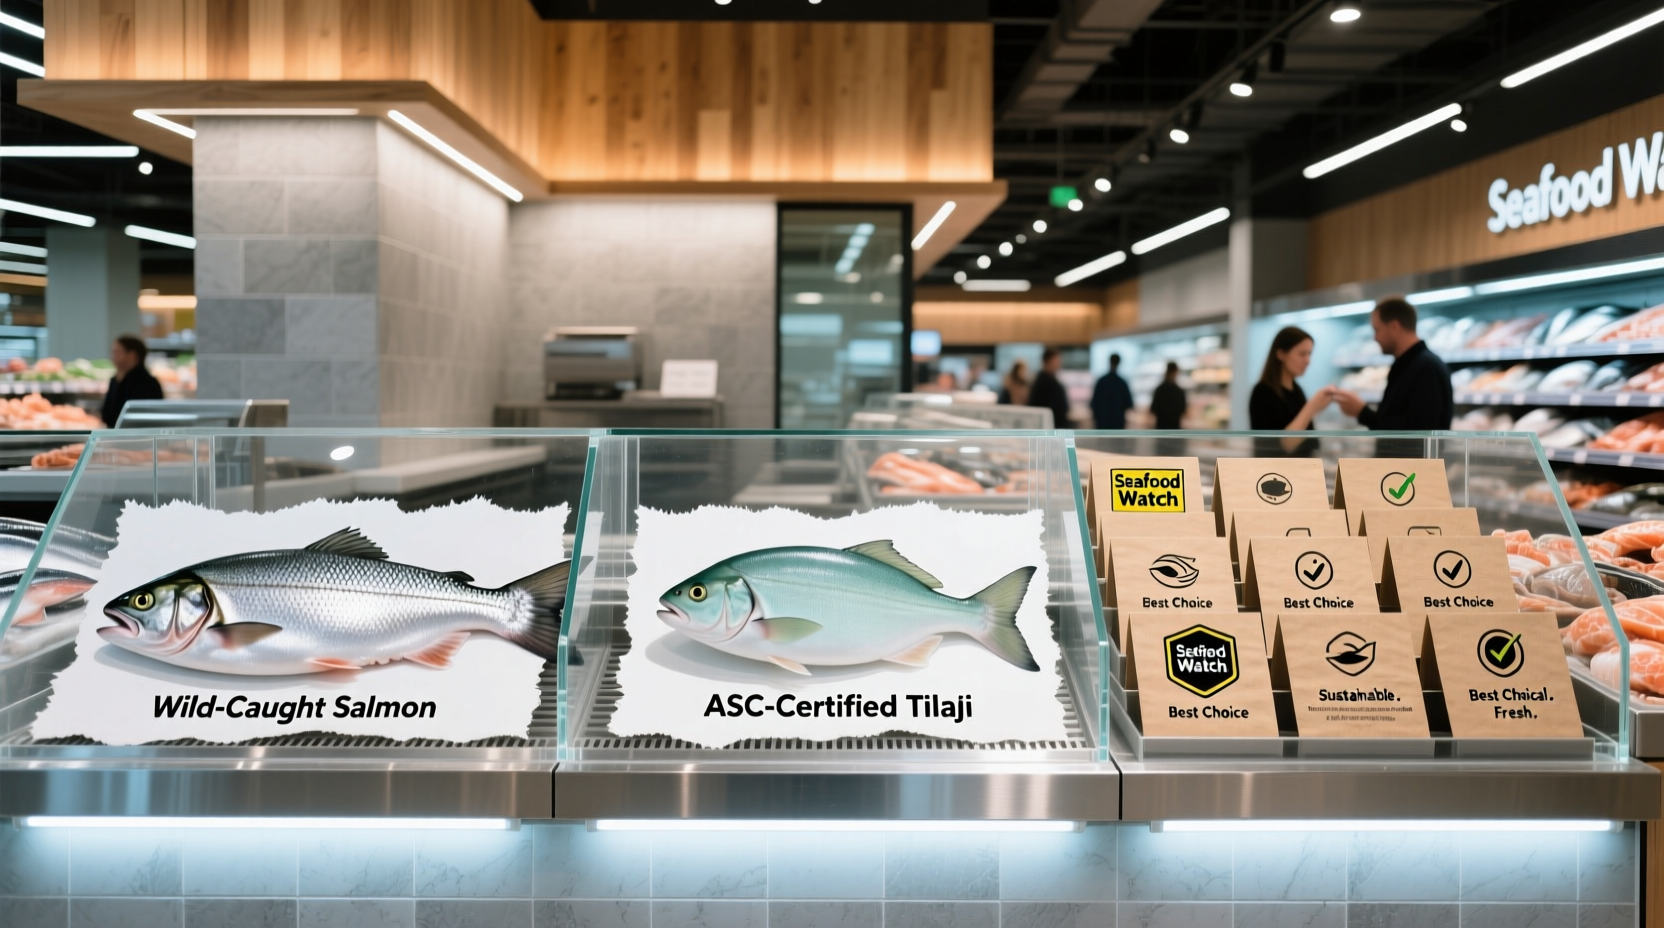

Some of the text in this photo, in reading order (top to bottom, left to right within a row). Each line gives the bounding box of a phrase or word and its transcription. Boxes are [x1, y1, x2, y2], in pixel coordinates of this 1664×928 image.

[1487, 146, 1614, 234] Seafood
[1114, 472, 1181, 489] Seafood
[1117, 489, 1179, 507] Watch
[1142, 596, 1169, 609] Best
[1284, 596, 1311, 609] Best
[1423, 596, 1451, 608] Best
[1176, 657, 1228, 674] Watch
[1468, 688, 1500, 702] Best
[154, 695, 437, 725] Wild-Caught Salmon
[703, 693, 973, 724] ASC-Certified Tilaji
[1168, 705, 1250, 719] Best Choice
[1494, 704, 1538, 719] Fresh.
